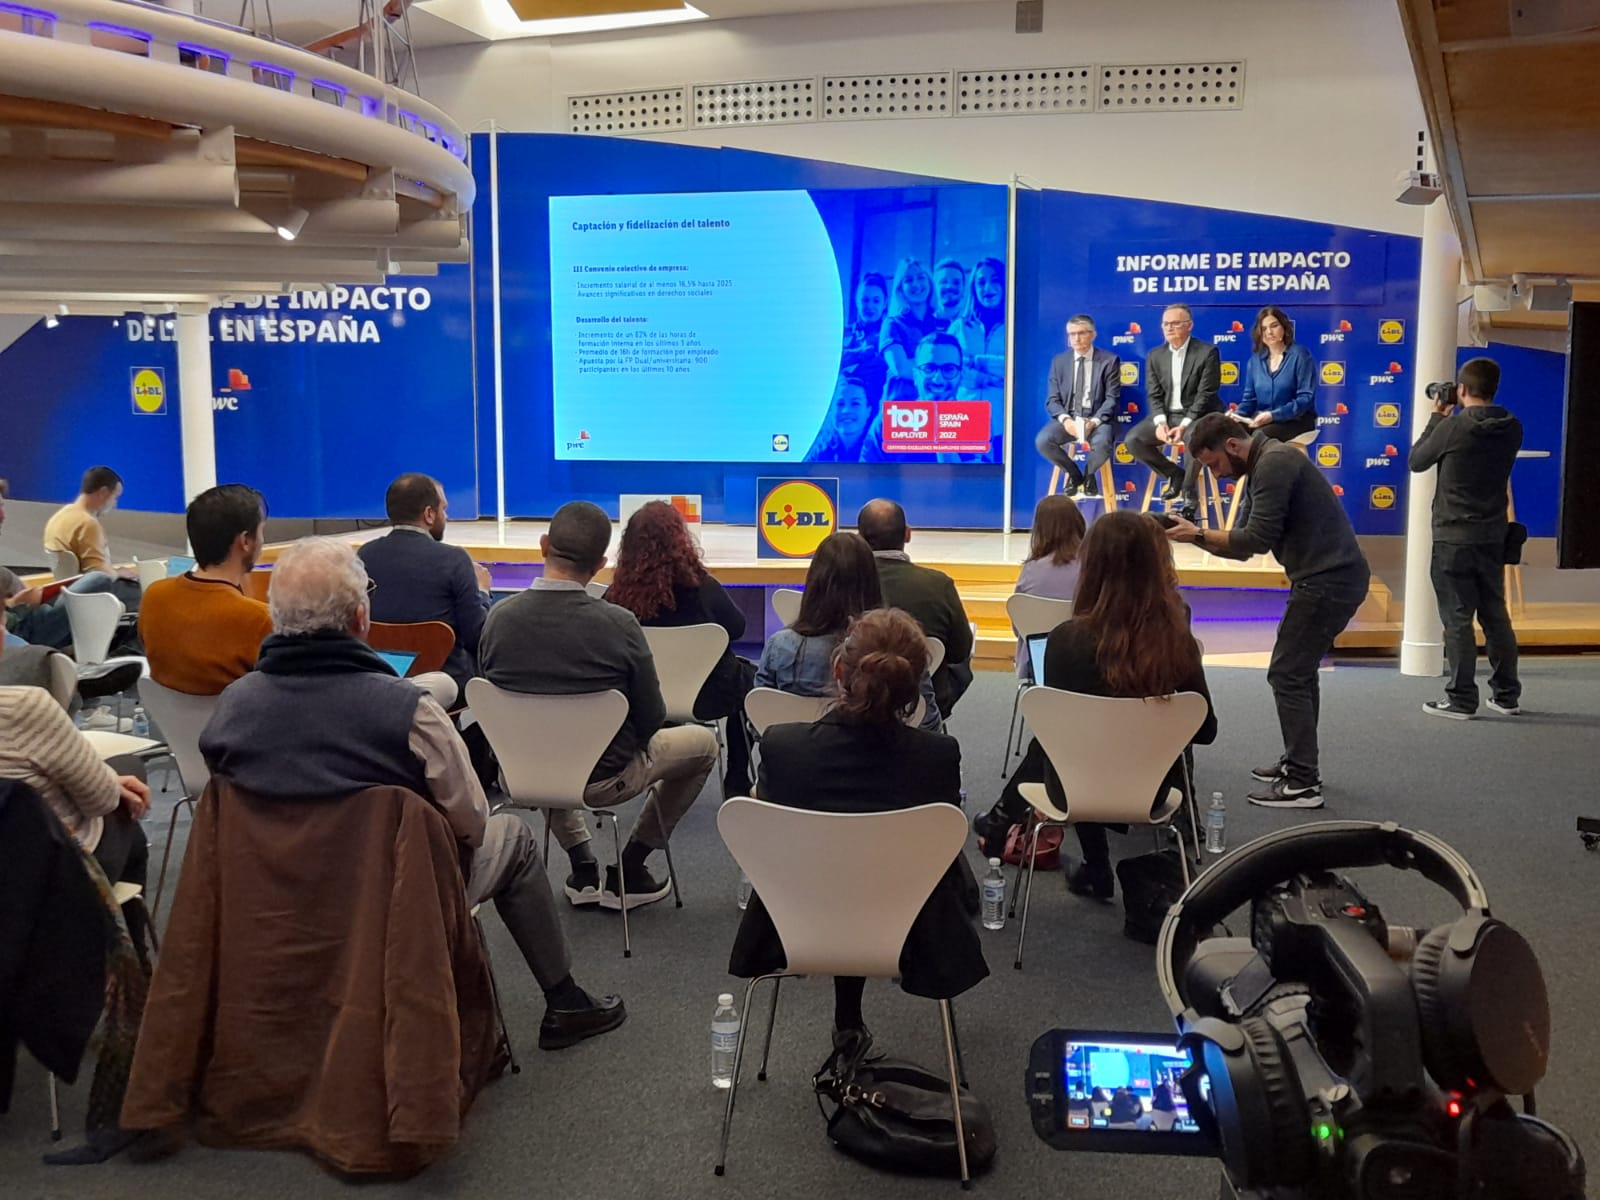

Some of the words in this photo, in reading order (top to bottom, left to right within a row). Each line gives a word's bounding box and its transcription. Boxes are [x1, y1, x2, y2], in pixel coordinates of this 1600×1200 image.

[572, 220, 616, 232] Captación
[618, 222, 625, 232] y
[626, 219, 679, 230] fidelización
[681, 219, 695, 228] del
[697, 218, 730, 228] talento
[1116, 254, 1210, 272] INFORME
[1216, 253, 1243, 269] DE
[1248, 251, 1350, 269] IMPACTO
[584, 265, 615, 273] Convenio
[617, 264, 647, 272] colectivo
[648, 264, 657, 272] de
[577, 280, 613, 289] Incremento
[615, 280, 638, 288] salarial
[639, 280, 647, 288] de
[698, 279, 715, 287] hasta
[717, 279, 733, 287] 2025
[1133, 276, 1158, 293] DE
[1163, 275, 1209, 292] LIDL
[1214, 274, 1241, 291] EN
[1247, 271, 1331, 291] ESPAÑA
[288, 286, 431, 310] IMPACTO
[577, 290, 603, 298] Avances
[605, 289, 646, 299] significativos
[657, 289, 686, 297] derechos
[687, 288, 713, 297] sociales
[576, 316, 609, 324] Desarrollo
[611, 315, 622, 323] del
[126, 319, 155, 341] DE
[219, 318, 255, 342] EN
[265, 314, 381, 343] ESPAÑA
[579, 331, 614, 339] Incremento
[659, 330, 668, 338] las
[669, 330, 687, 338] horas
[1214, 334, 1237, 345] pwc
[1320, 333, 1344, 344] pwc
[579, 339, 610, 347] formación
[611, 339, 634, 347] interna
[645, 339, 654, 347] los
[1112, 335, 1135, 346] pwc
[579, 348, 609, 356] Promedio
[610, 348, 618, 356] de
[675, 349, 686, 358] por
[687, 348, 719, 357] empleado
[579, 366, 619, 374] participantes
[1369, 374, 1394, 386] pwc
[212, 397, 239, 410] wc
[887, 404, 929, 432] top
[939, 412, 970, 421] ESPAÑA
[1117, 415, 1132, 423] wc
[1317, 416, 1341, 427] pwc
[939, 431, 957, 439] 2022
[1365, 458, 1390, 468] pwc
